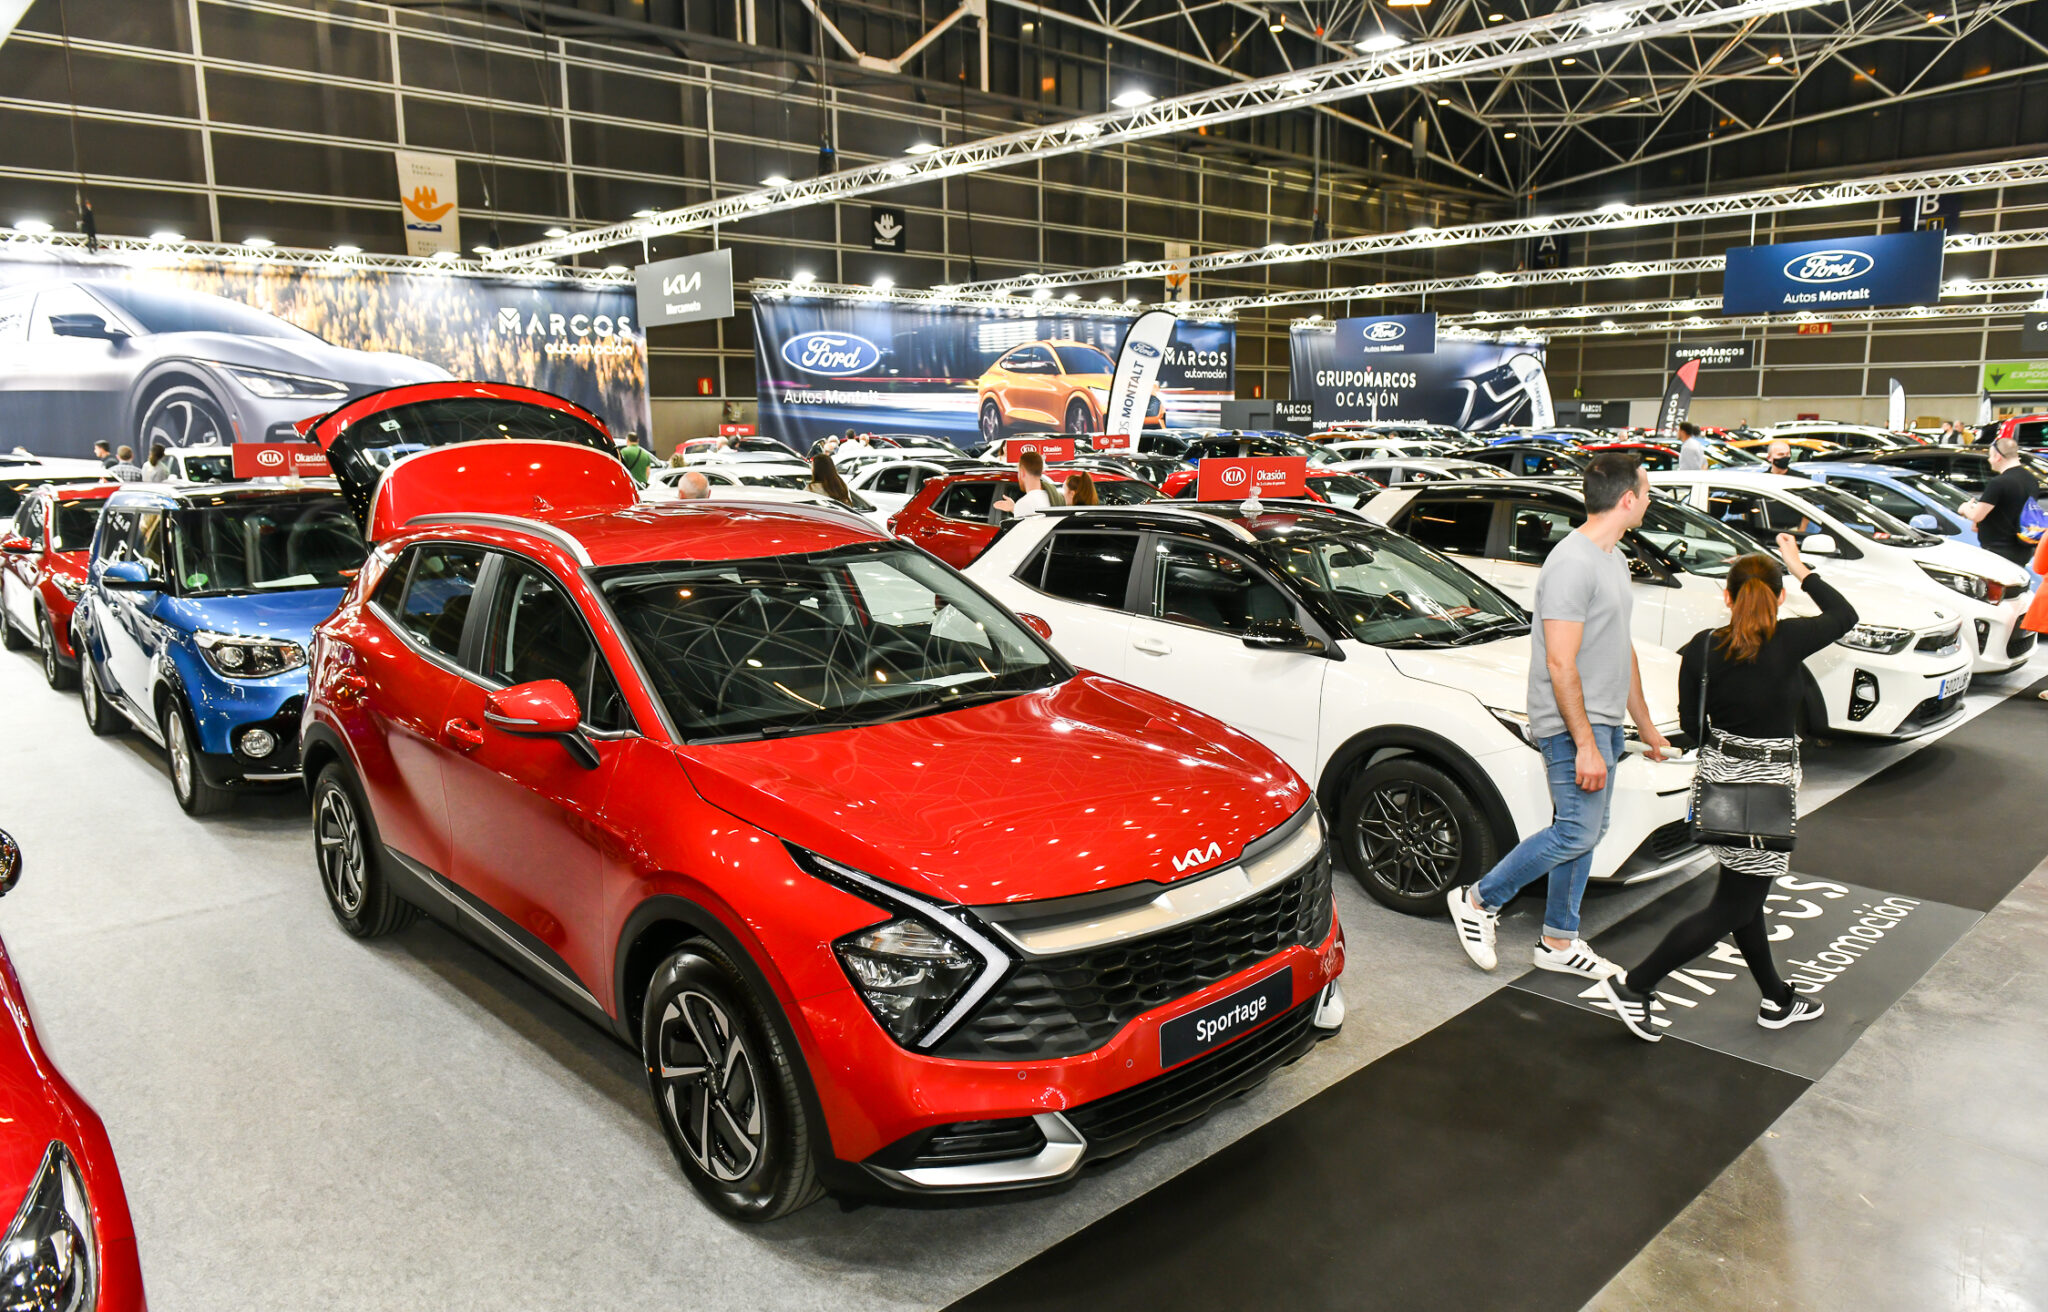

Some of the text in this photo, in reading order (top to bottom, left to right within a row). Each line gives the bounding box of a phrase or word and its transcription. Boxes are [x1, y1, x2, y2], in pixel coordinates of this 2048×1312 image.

[1921, 194, 1940, 215] B
[1539, 235, 1556, 252] A
[1800, 254, 1857, 279] Ford
[662, 272, 701, 296] KIA
[1783, 288, 1871, 304] Autos Montalt
[498, 307, 632, 338] MARCOS
[1370, 324, 1398, 338] Ford
[544, 340, 633, 356] automoción
[801, 336, 862, 369] Ford
[1164, 347, 1228, 367] MARCOS
[1184, 368, 1228, 379] automoción
[1315, 369, 1417, 388] GRUPOMARCOS
[783, 389, 823, 404] Autos
[1121, 360, 1145, 418] MONTALT
[1335, 389, 1399, 407] OCASIÓN
[1276, 402, 1312, 414] MARCOS
[261, 452, 327, 463] KIA Okasión
[1225, 469, 1287, 482] KIA Okasión
[1172, 842, 1222, 872] KIA
[1784, 897, 1921, 993] automoción
[1196, 995, 1267, 1042] Sportage
